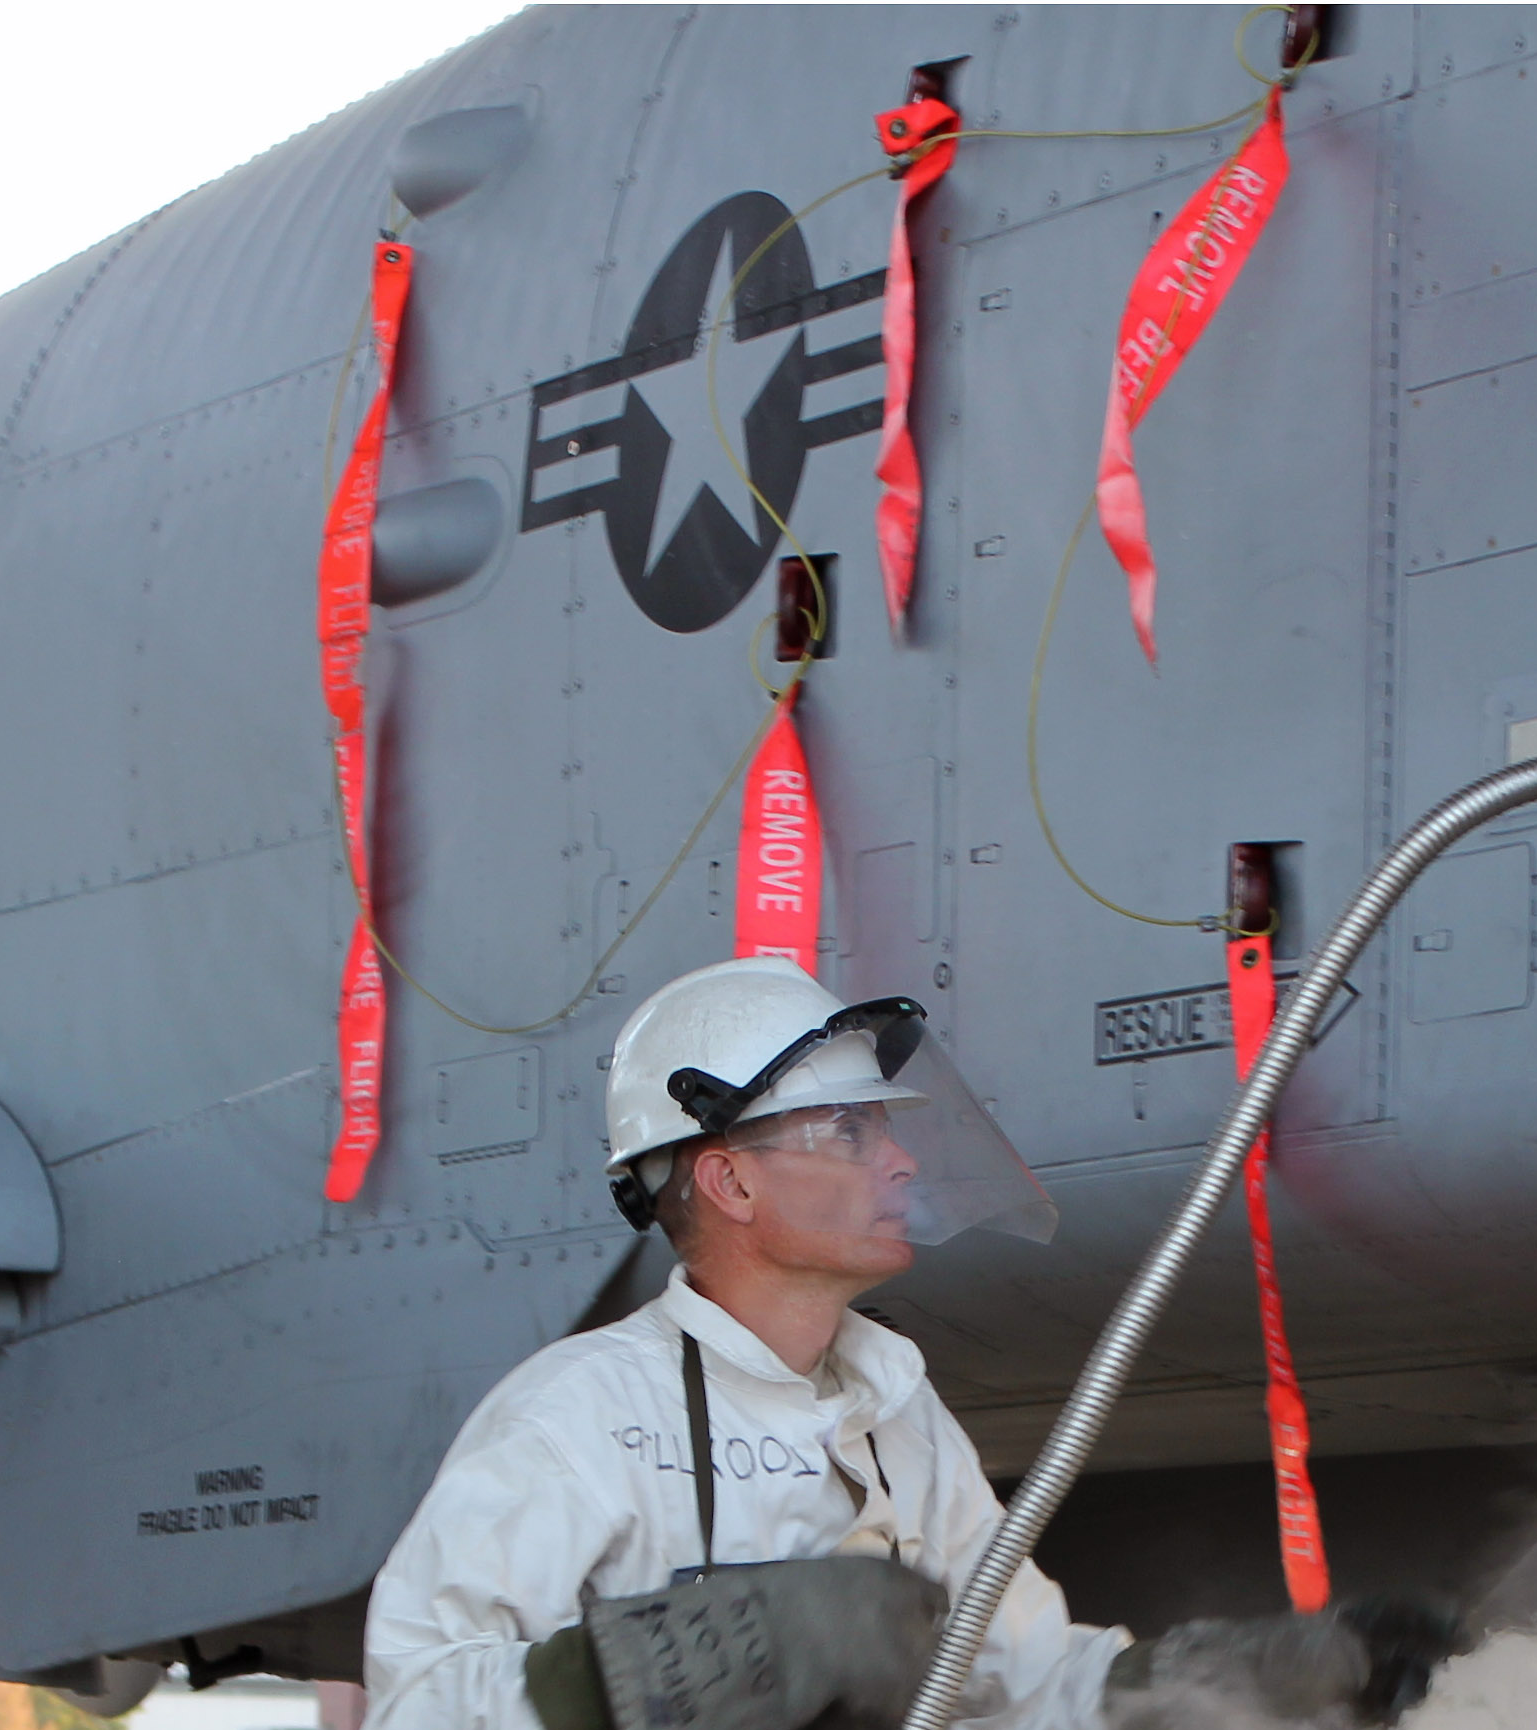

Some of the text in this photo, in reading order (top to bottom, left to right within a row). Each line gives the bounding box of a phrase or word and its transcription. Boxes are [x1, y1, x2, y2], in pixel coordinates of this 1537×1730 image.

[1158, 163, 1267, 313] REMOVE
[756, 768, 807, 914] REMOVE
[1102, 996, 1205, 1054] RESCUE
[342, 1039, 381, 1152] FLIGHT
[137, 1507, 199, 1536] FRAGILE
[201, 1503, 226, 1531] DO
[228, 1500, 261, 1528] NOT
[194, 1464, 265, 1496] WARNING
[1276, 1422, 1317, 1565] FLIGHT
